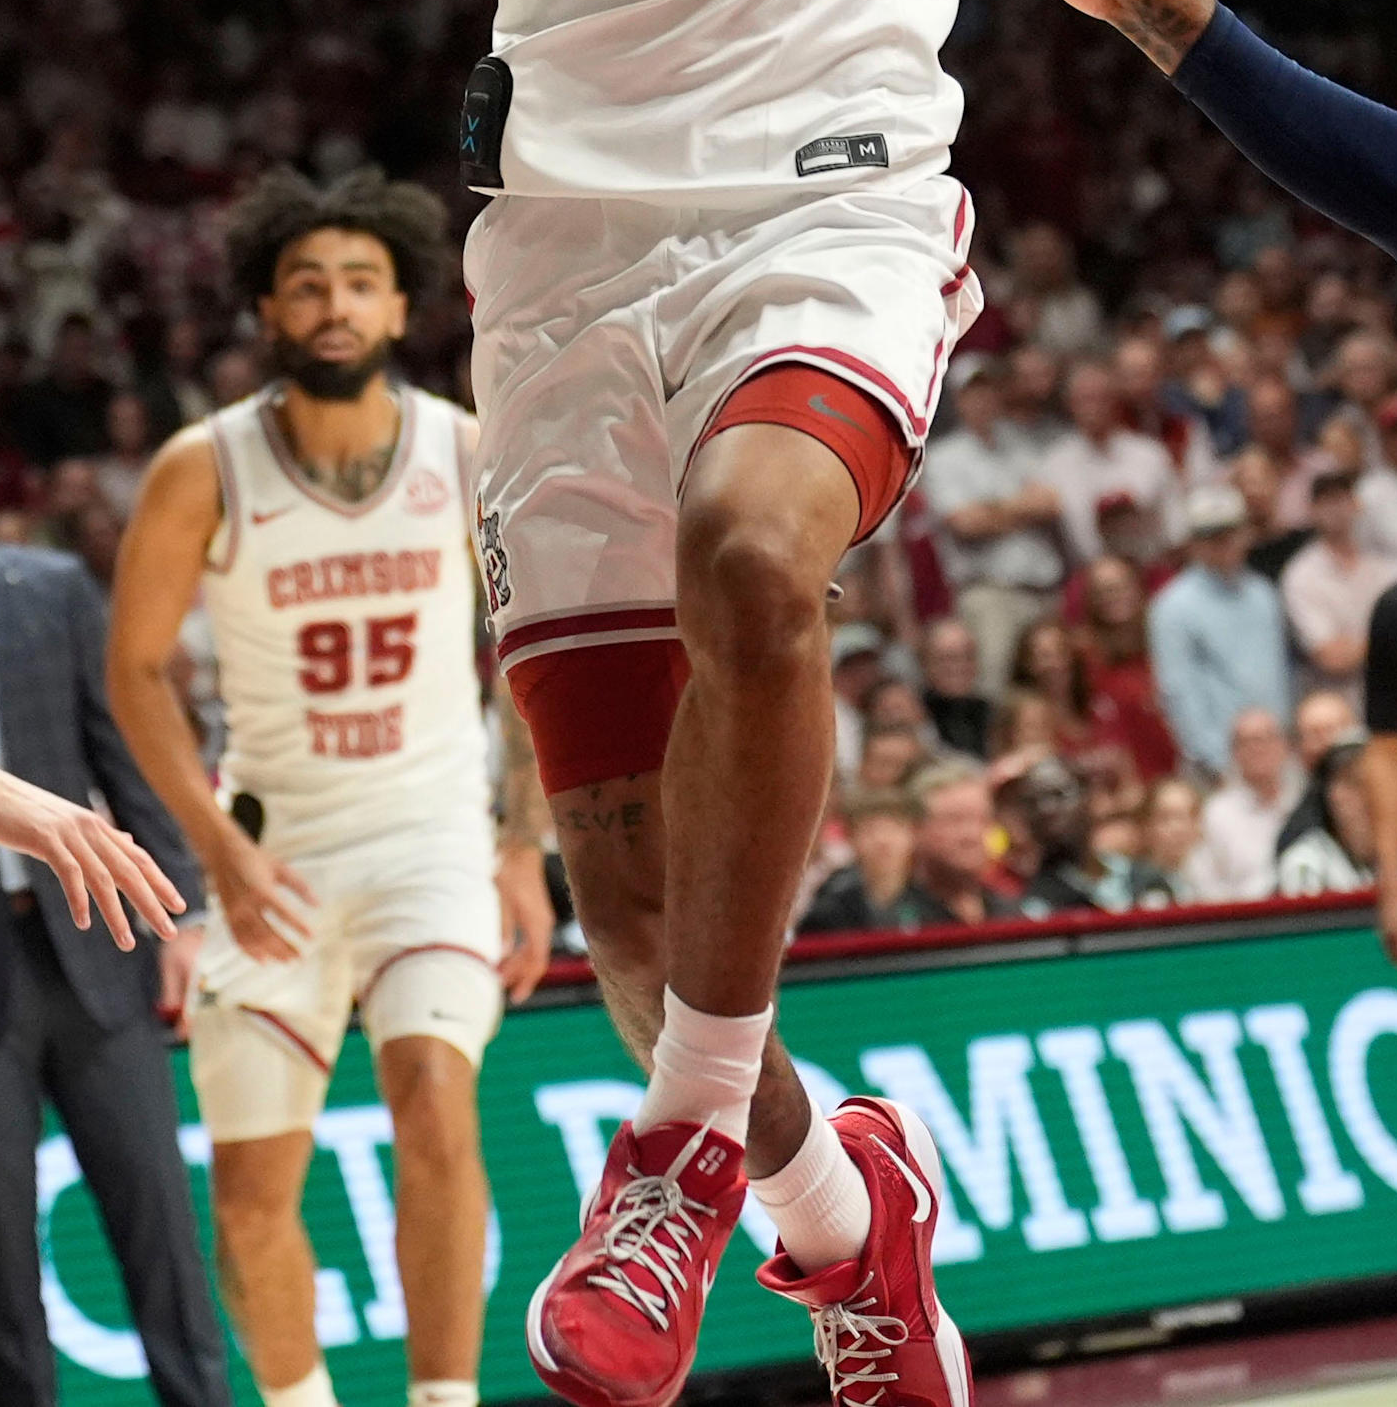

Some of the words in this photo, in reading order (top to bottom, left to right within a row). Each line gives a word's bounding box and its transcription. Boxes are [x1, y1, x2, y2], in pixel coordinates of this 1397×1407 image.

[859, 142, 876, 157] M
[267, 549, 441, 609] CRIMSON
[297, 614, 419, 694] 95
[305, 706, 406, 759] TIDE
